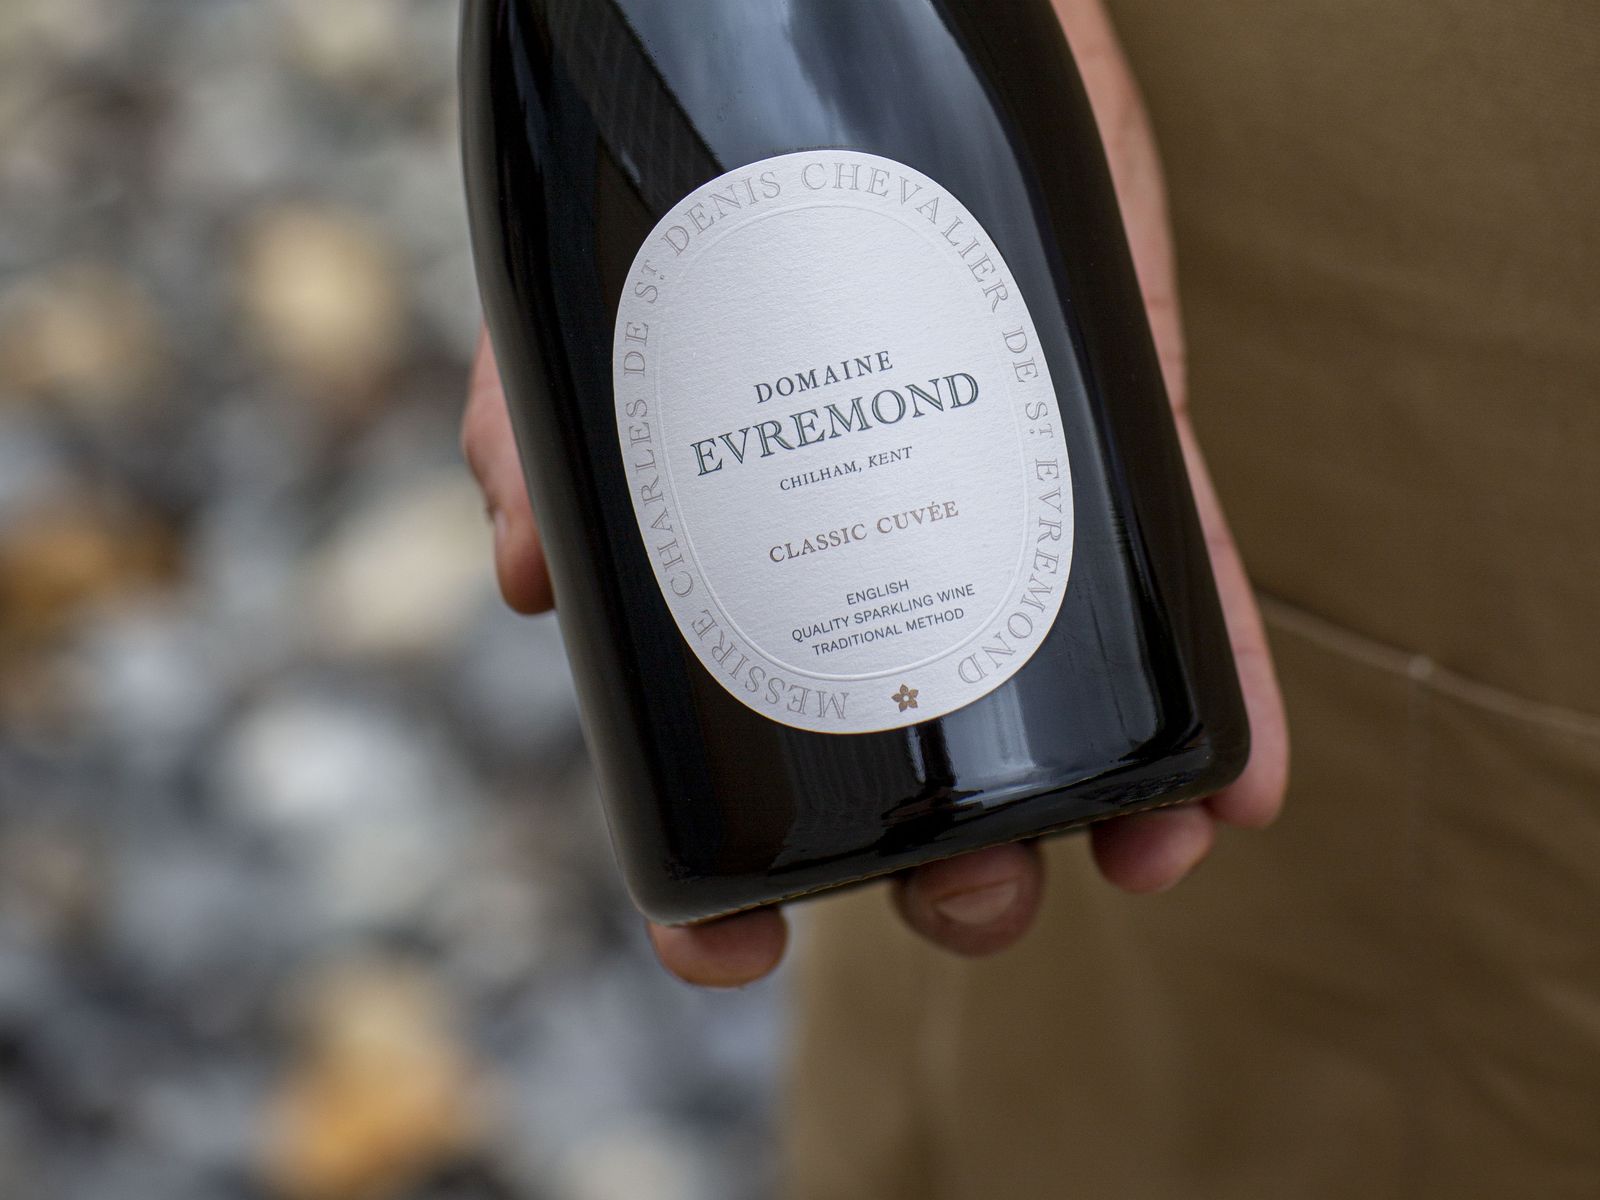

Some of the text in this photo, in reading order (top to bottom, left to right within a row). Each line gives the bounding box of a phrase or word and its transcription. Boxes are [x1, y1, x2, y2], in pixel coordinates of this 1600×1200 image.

[661, 171, 782, 256] DENIS
[801, 162, 1009, 313] CHEVALIER
[623, 321, 649, 377] DE
[753, 350, 894, 404] DOMAINE
[1001, 325, 1039, 384] DE
[690, 372, 980, 477] EVREMOND
[625, 399, 694, 598] CHARLES
[779, 446, 913, 492] CHILHAM, KENT
[769, 500, 960, 564] CLASSIC CUVÉE
[846, 578, 910, 606] ENGLISH
[957, 457, 1063, 685] EVREMOND
[791, 583, 976, 643] QUALITY SPARKLING WINE
[812, 607, 965, 657] TRADITIONAL METHOD
[691, 609, 849, 720] MESSIRE
